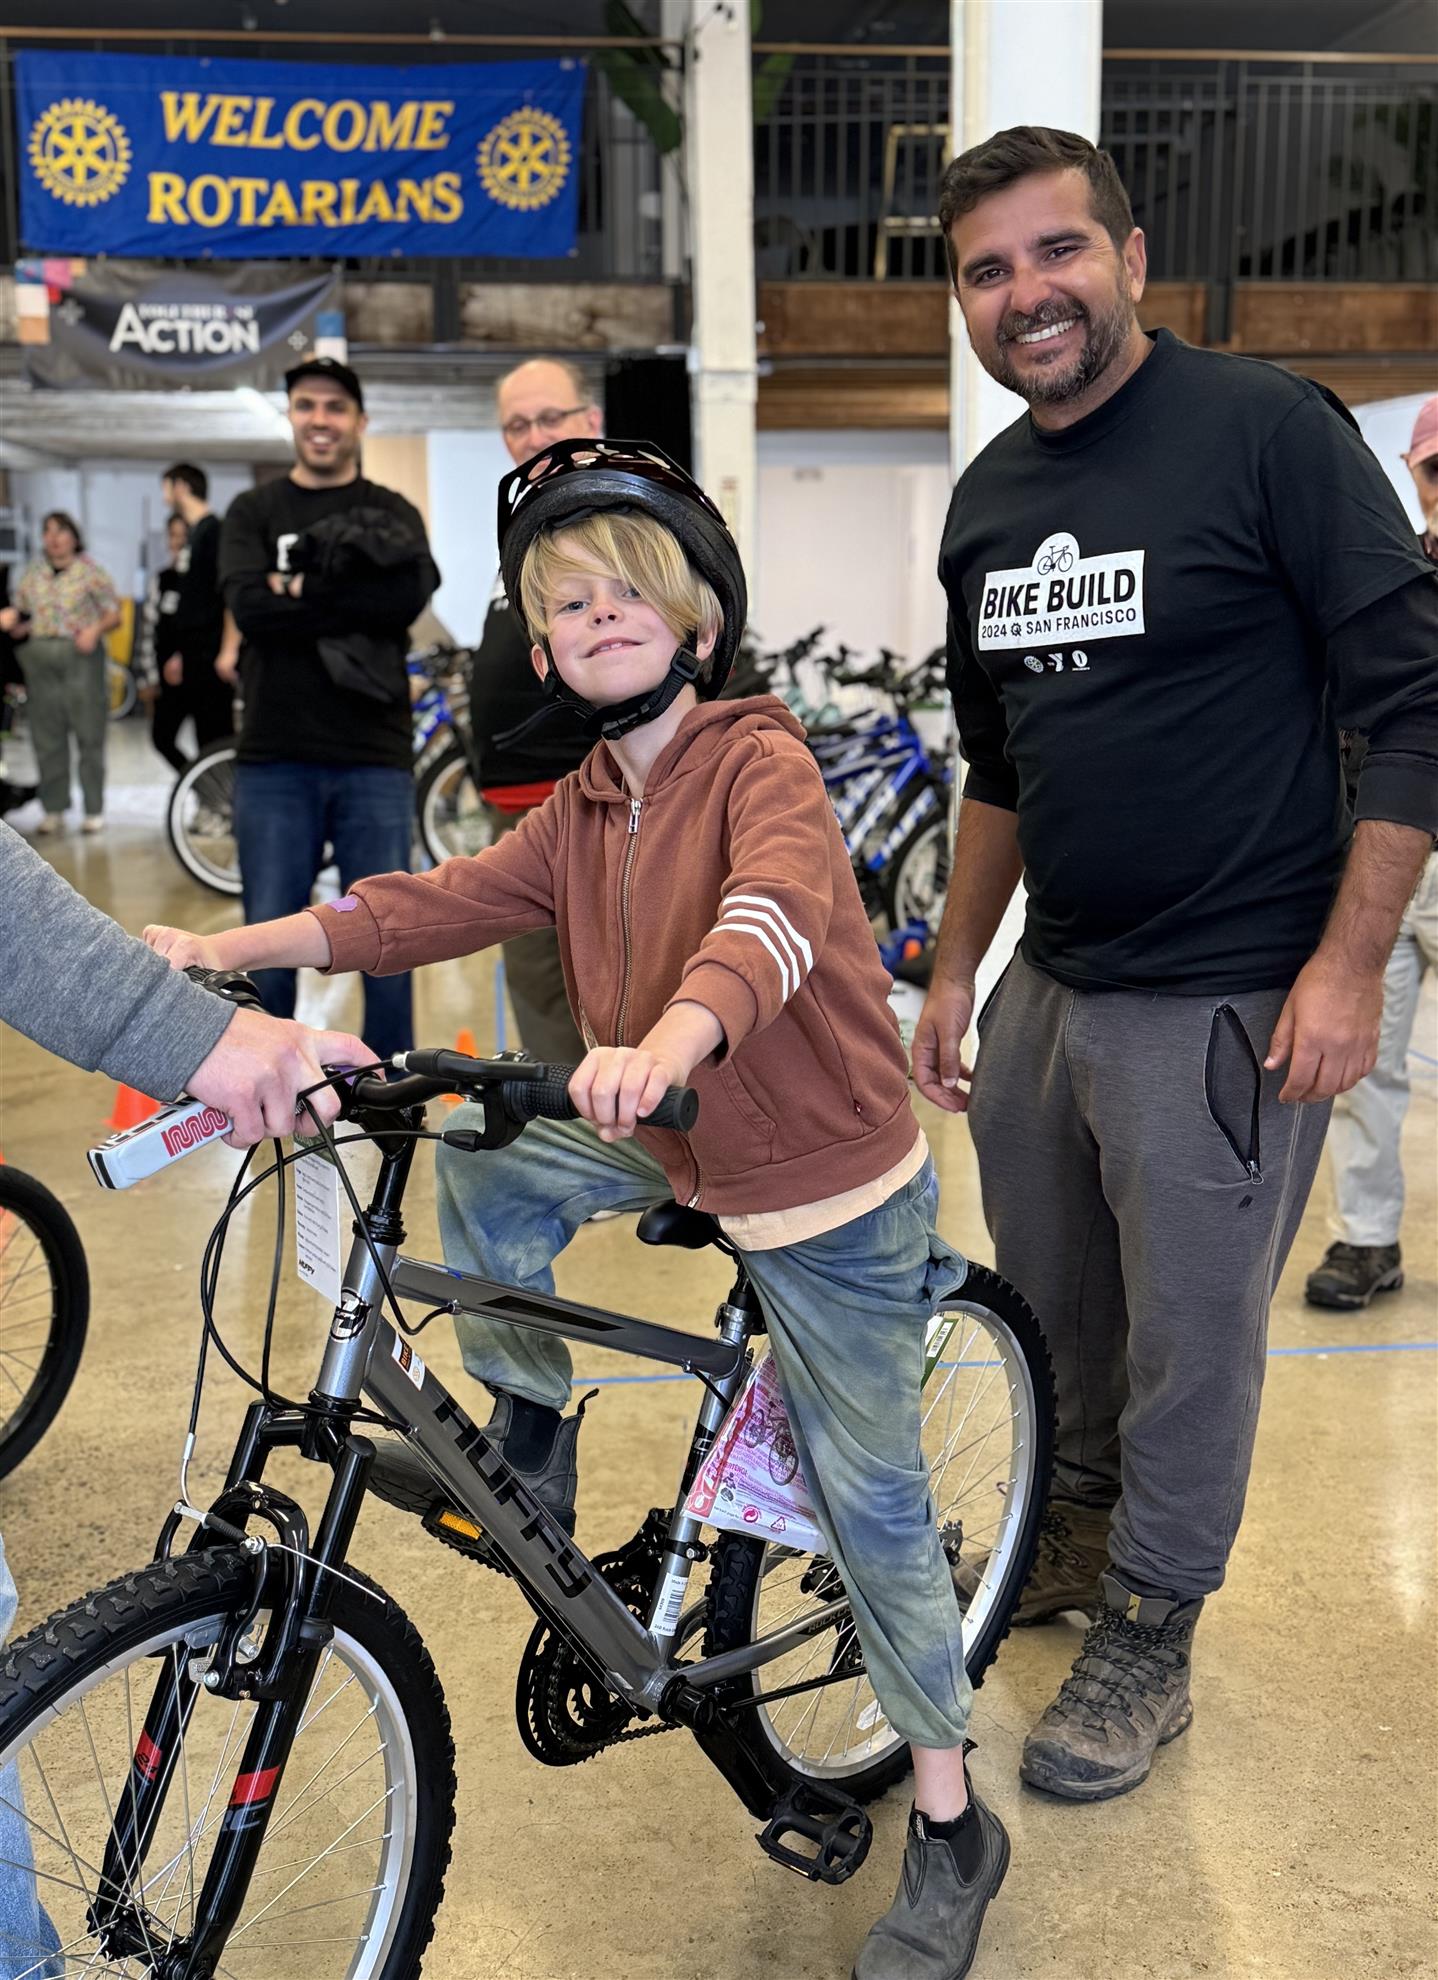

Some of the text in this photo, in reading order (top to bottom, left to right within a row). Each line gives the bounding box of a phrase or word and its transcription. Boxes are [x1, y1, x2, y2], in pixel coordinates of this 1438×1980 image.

[160, 91, 454, 151] WELCOME
[147, 171, 464, 227] ROTARIANS
[109, 302, 260, 354] ACTION
[983, 568, 1136, 620] BIKE BUILD
[981, 608, 1136, 639] 2024 SAN FRANCISCO
